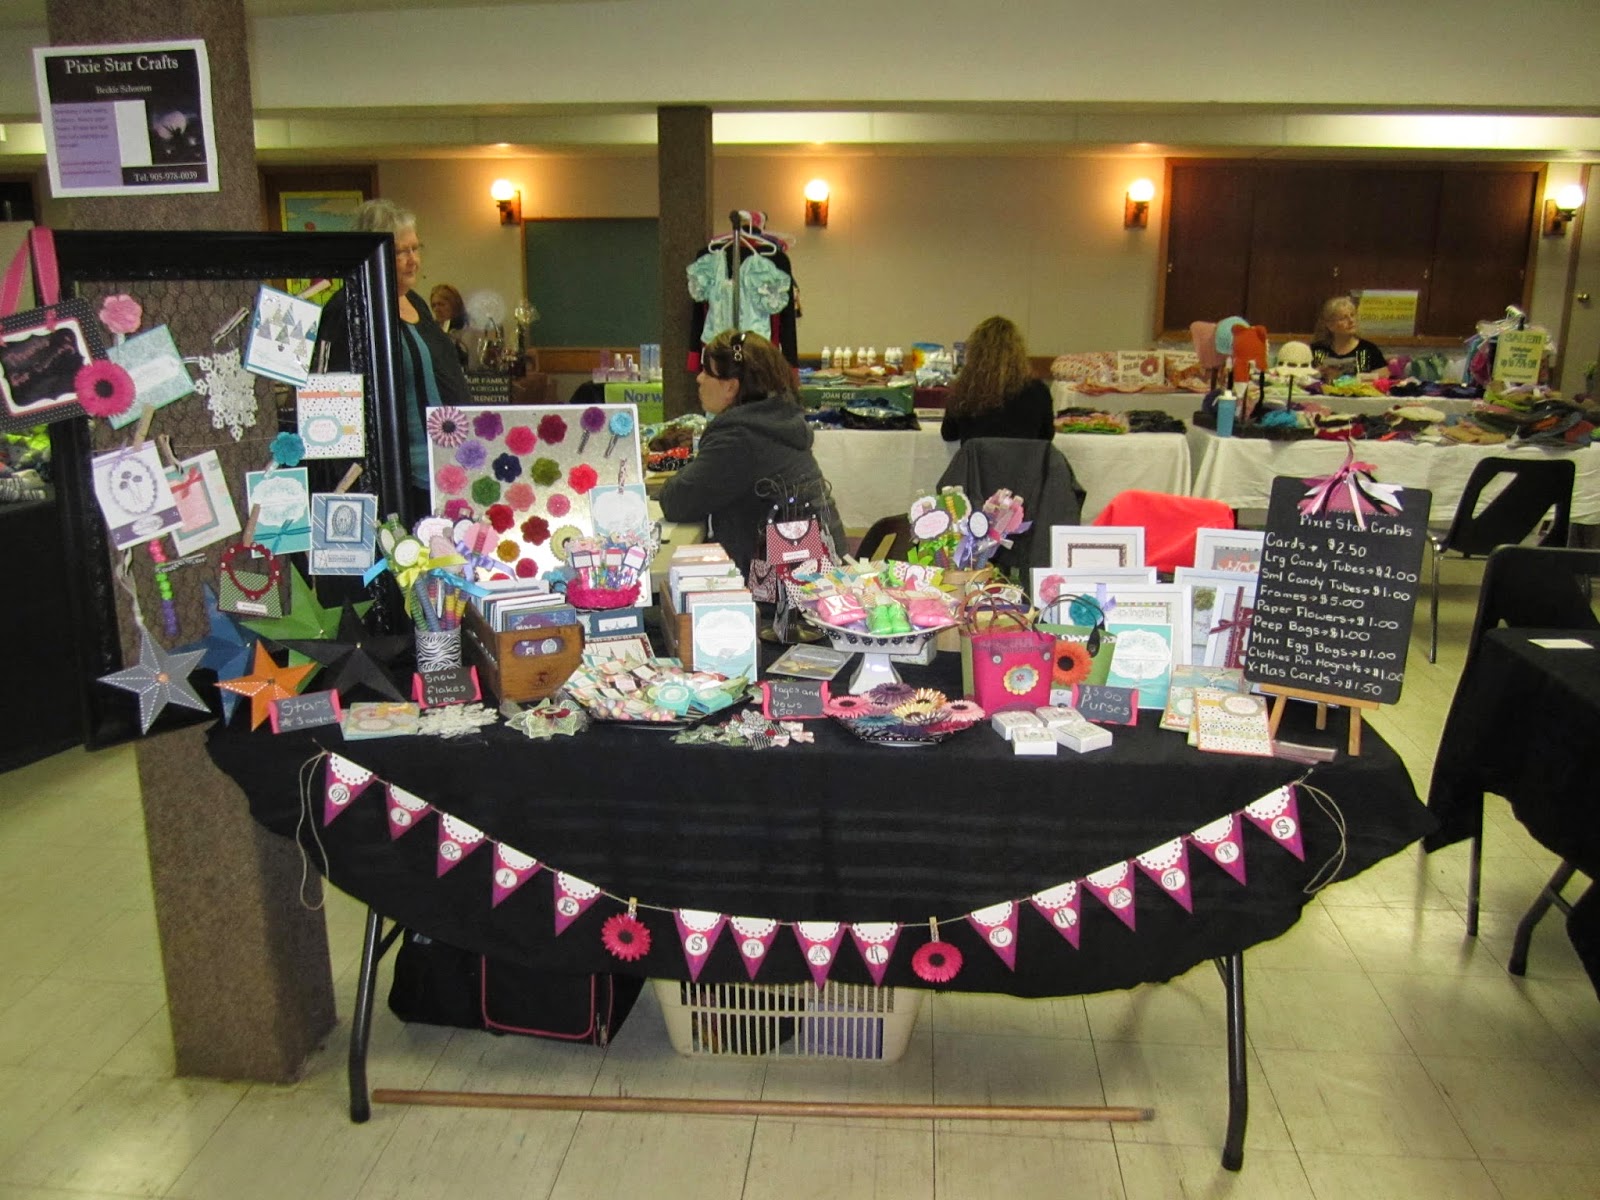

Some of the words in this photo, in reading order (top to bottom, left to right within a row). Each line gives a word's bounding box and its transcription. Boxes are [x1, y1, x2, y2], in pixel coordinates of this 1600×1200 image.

[64, 59, 101, 74] Pixie
[104, 57, 133, 72] Star
[136, 54, 179, 71] Crafts
[1265, 531, 1306, 551] Cards
[1370, 522, 1413, 537] Crafts
[1264, 551, 1286, 567] Lrg
[1290, 553, 1328, 572] Candy
[1331, 559, 1365, 575] Tubes
[1375, 566, 1417, 583] $2.00
[1260, 584, 1307, 601] Frames
[1319, 594, 1364, 609] $5.00
[1287, 573, 1324, 591] Candy
[1329, 579, 1365, 594] Tubes
[1372, 585, 1411, 601] $1.00
[1256, 600, 1292, 615] Paper
[1296, 606, 1346, 624] Flowers
[1356, 616, 1399, 630] $1.00
[1254, 615, 1283, 632] Peep
[1289, 621, 1323, 638] Bags
[1329, 627, 1370, 641] $1.00
[1252, 631, 1280, 645] Mini
[1287, 638, 1309, 656] Egg
[1315, 642, 1348, 658] Bags
[1359, 648, 1396, 660] $1.00
[1248, 647, 1290, 662] Clothes
[1295, 655, 1312, 665] Pin
[1315, 659, 1362, 675] Magnets
[424, 672, 457, 683] Snow
[1290, 667, 1330, 686] Cards
[1345, 679, 1382, 696] $1.50
[772, 698, 803, 709] bows
[801, 689, 820, 697] and
[281, 699, 331, 716] Stars
